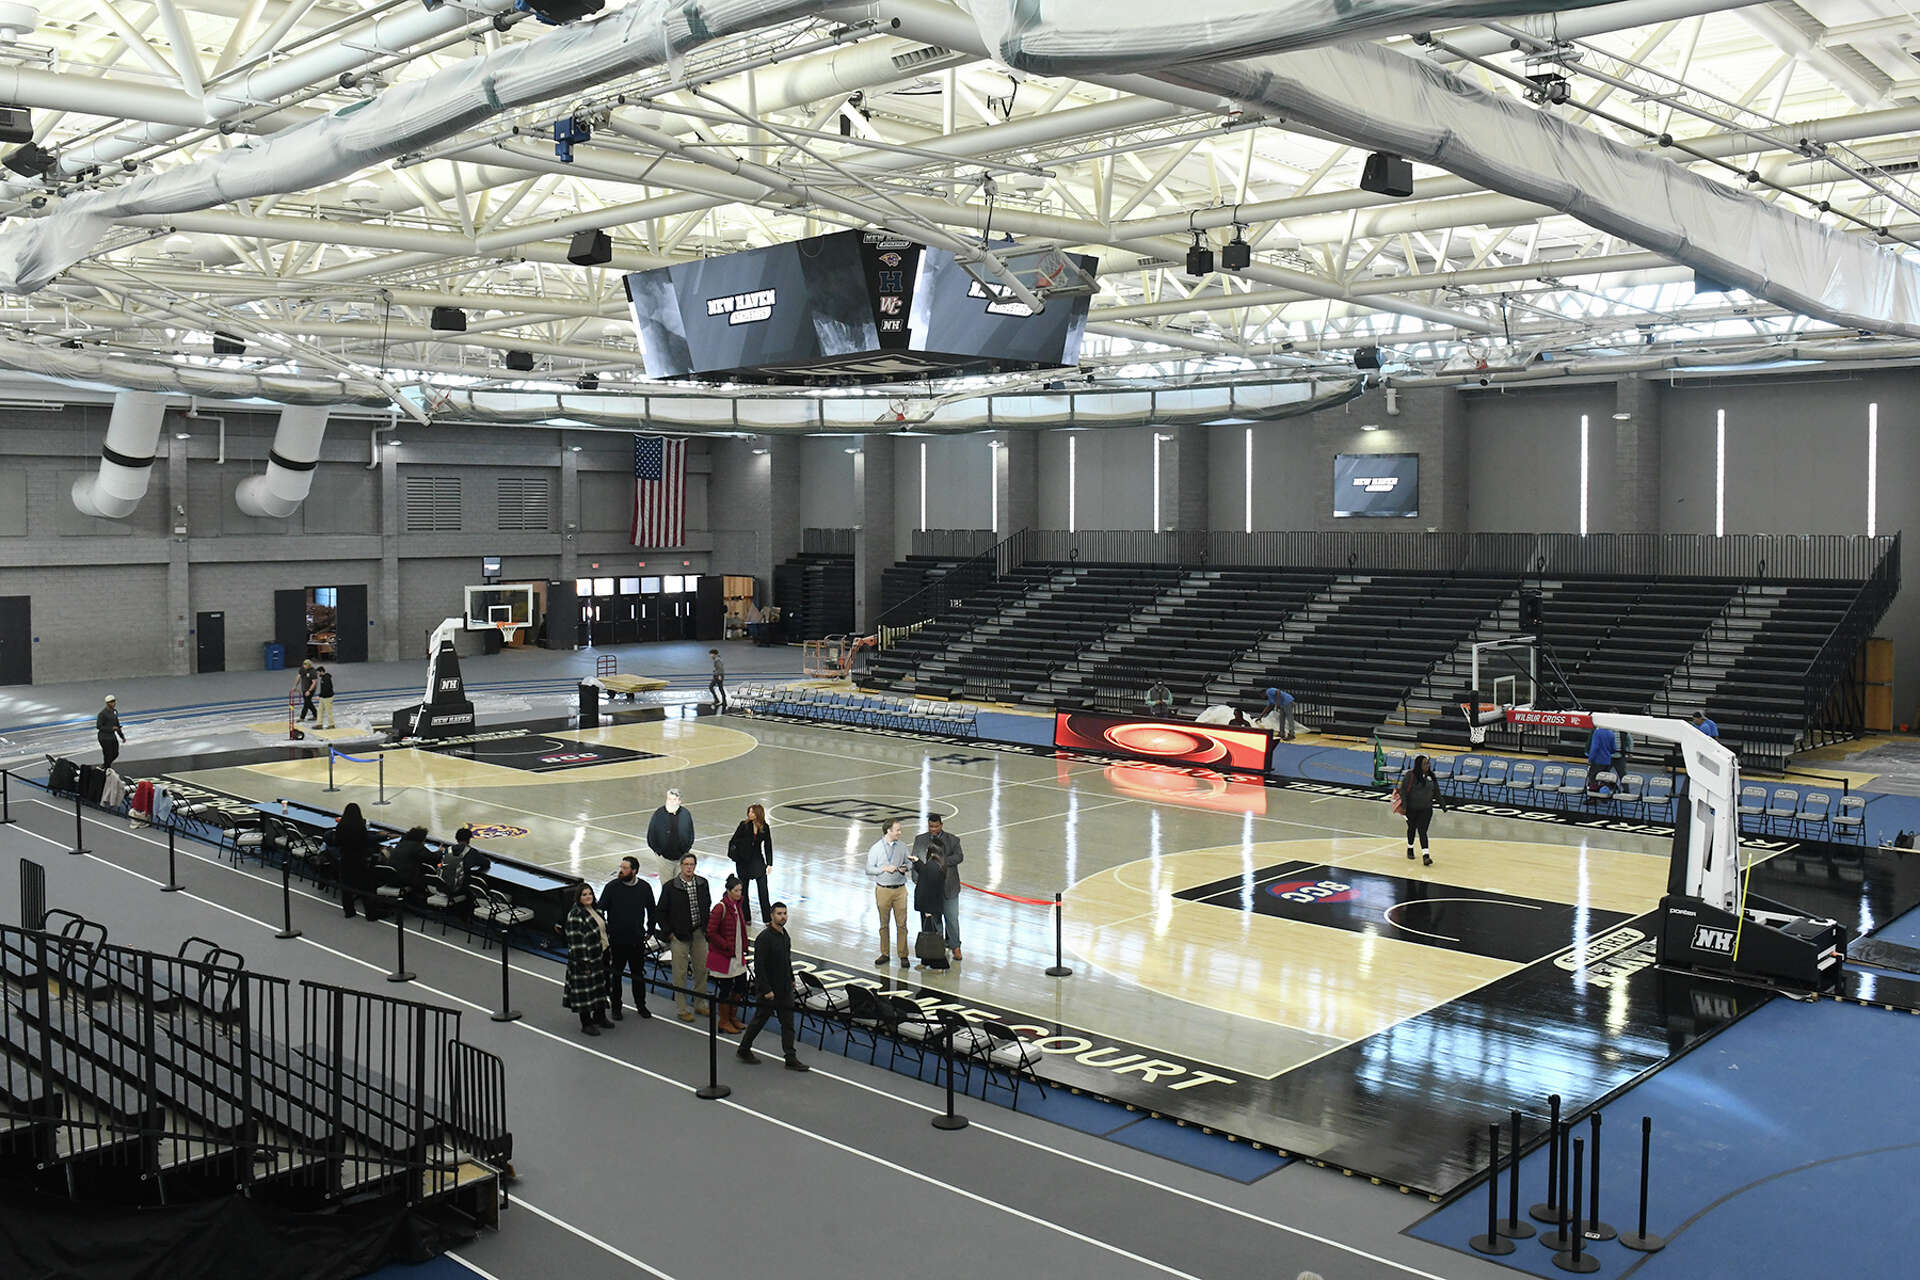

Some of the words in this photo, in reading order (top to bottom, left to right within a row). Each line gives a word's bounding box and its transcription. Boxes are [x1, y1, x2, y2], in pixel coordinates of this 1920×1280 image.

[879, 271, 902, 292] H
[707, 296, 735, 315] NEW
[735, 289, 776, 310] HAVEN
[880, 296, 903, 315] WC
[882, 320, 901, 330] NH
[441, 679, 458, 690] NH
[1514, 712, 1541, 723] WILBUR
[1541, 714, 1566, 725] CROSS
[1280, 880, 1351, 904] SCC
[1669, 907, 1697, 917] porter
[1695, 927, 1735, 951] NH
[1008, 1023, 1238, 1091] COURT
